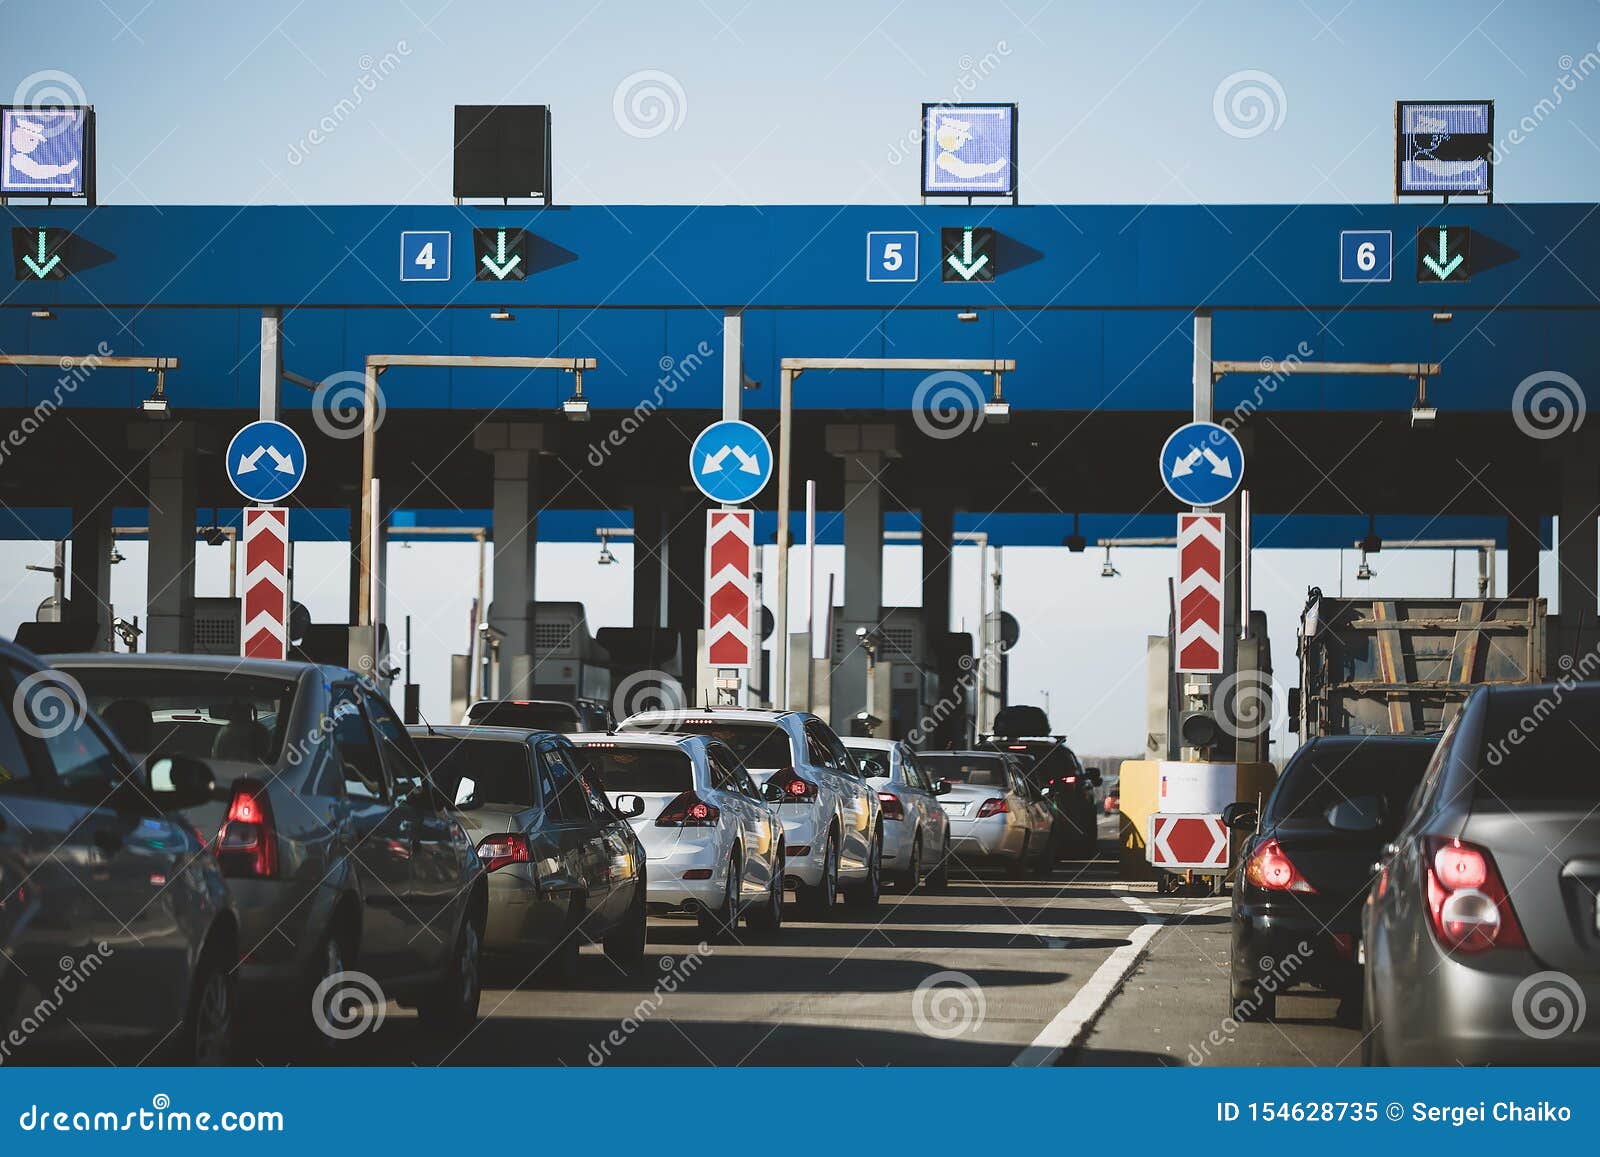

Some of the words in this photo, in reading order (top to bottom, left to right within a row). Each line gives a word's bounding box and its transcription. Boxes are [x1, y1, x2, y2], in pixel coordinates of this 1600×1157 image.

[415, 242, 436, 270] 4
[883, 243, 903, 271] 5
[1356, 242, 1376, 271] 6
